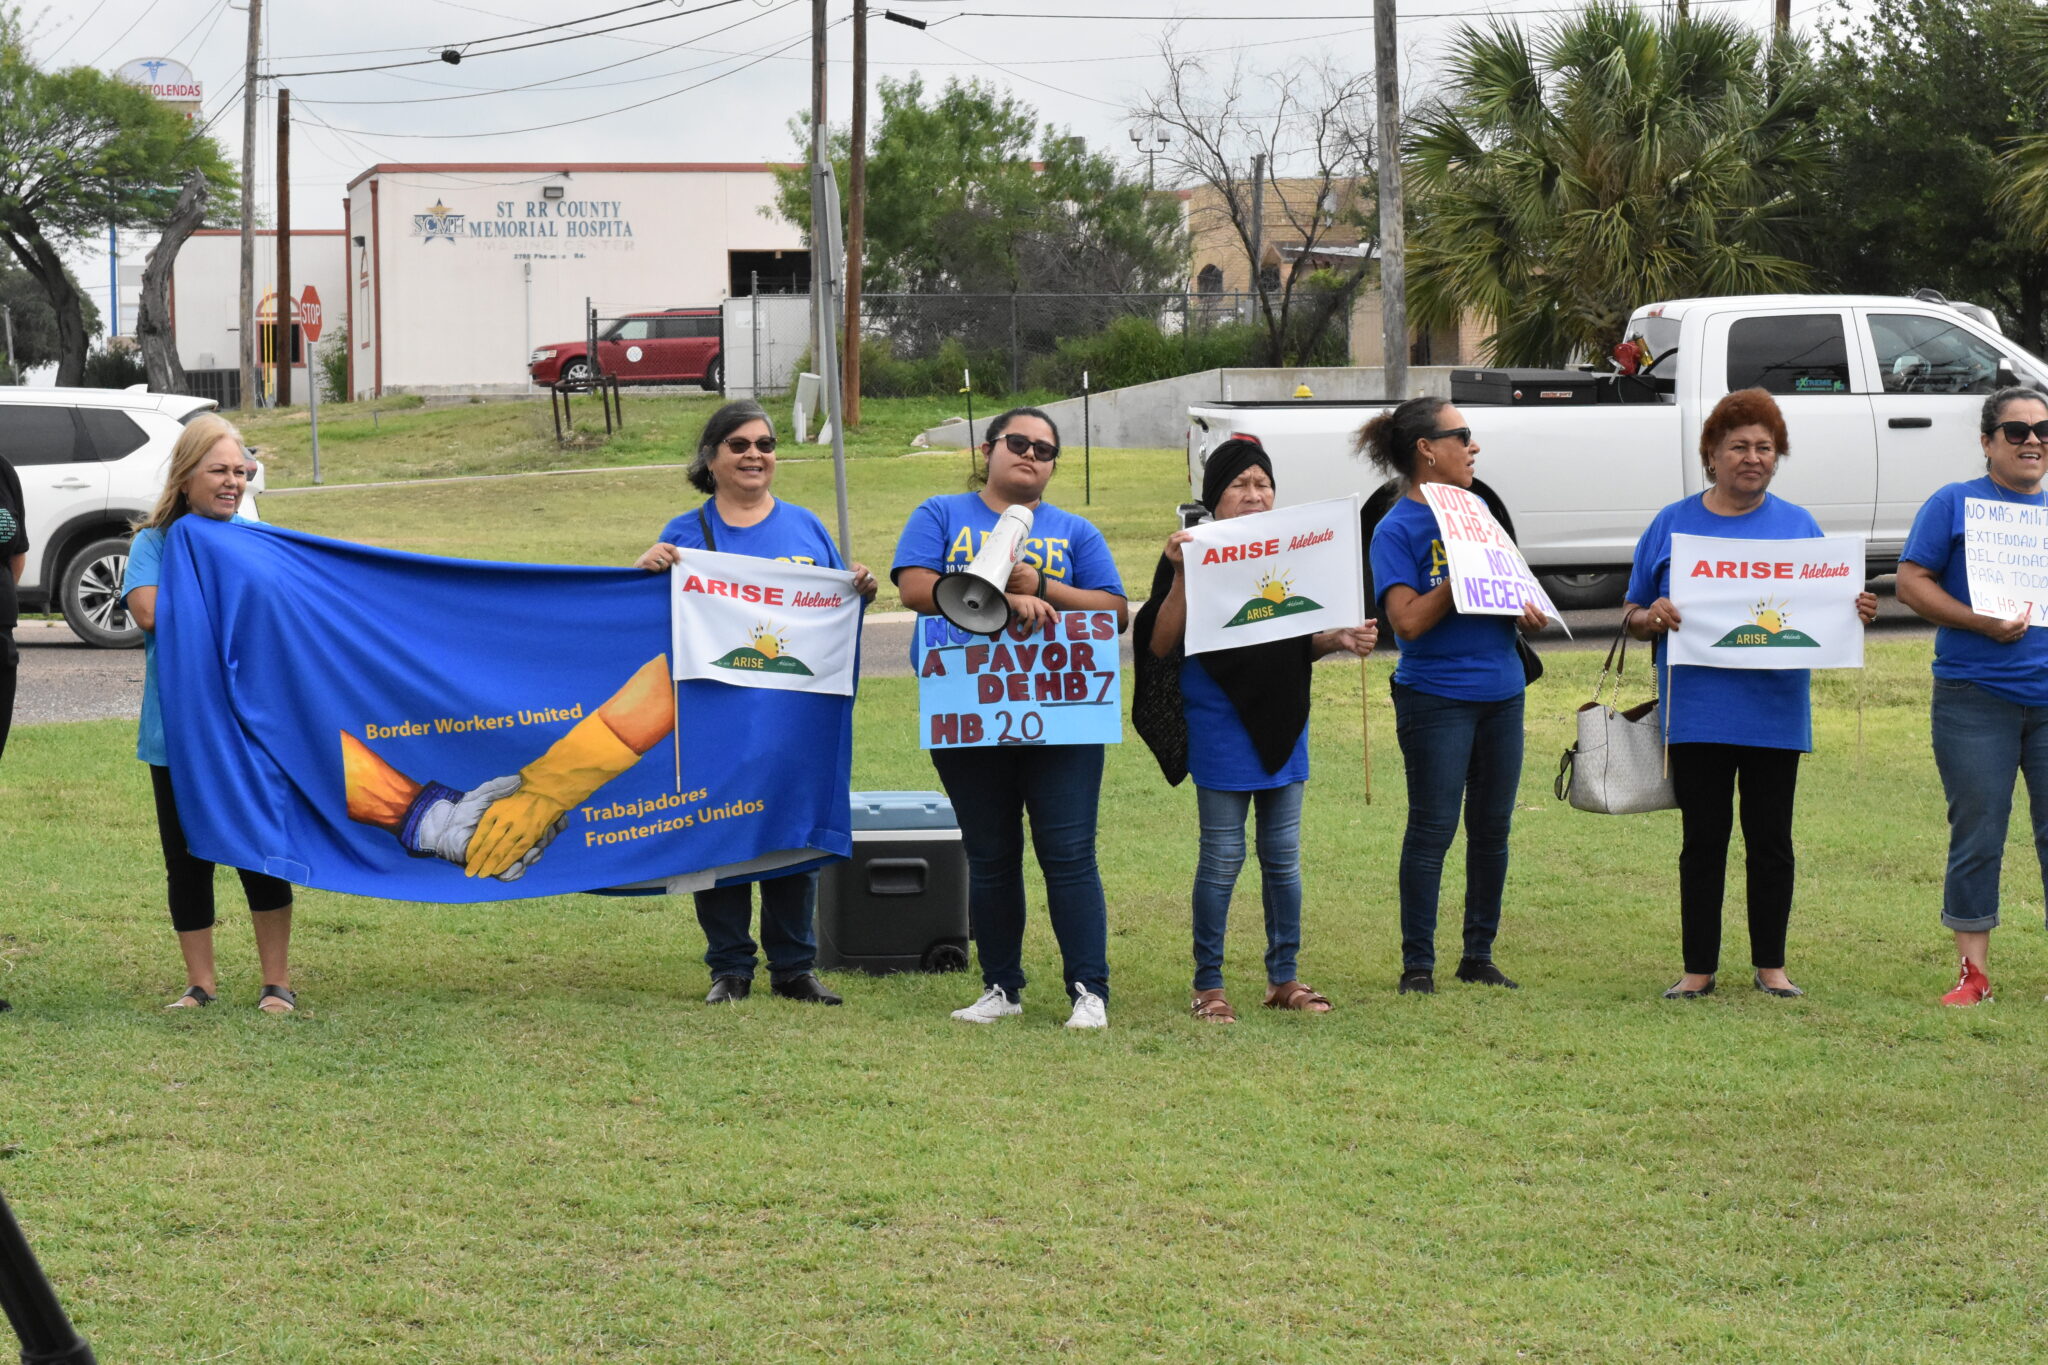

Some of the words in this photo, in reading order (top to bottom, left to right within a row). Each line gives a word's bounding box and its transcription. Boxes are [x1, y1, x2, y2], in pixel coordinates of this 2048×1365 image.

[557, 201, 621, 217] COUNTY
[413, 216, 465, 234] SCMH
[469, 221, 558, 237] MEMORIAL
[567, 221, 633, 237] HOSPITA
[302, 303, 321, 325] STOP
[1430, 485, 1478, 516] VOTE
[1966, 503, 1985, 519] NO
[1989, 504, 2013, 523] MAS
[1444, 512, 1461, 541] A
[1202, 539, 1280, 565] ARISE
[1288, 528, 1334, 552] Adelante
[1966, 529, 2037, 549] EXTIENDAN
[947, 526, 1069, 578] ASE
[1484, 548, 1512, 577] NO
[1967, 547, 1995, 563] DEL
[1690, 560, 1794, 579] ARISE
[1799, 562, 1850, 580] Adelante
[1968, 565, 2004, 585] PARA
[682, 575, 784, 606] ARISE
[792, 590, 842, 609] Adelante
[1247, 605, 1275, 621] ARISE
[1997, 596, 2018, 614] HB
[2023, 600, 2033, 617] 7
[925, 617, 973, 648] NO
[1736, 634, 1768, 645] ARISE
[733, 656, 764, 669] ARISE
[921, 649, 946, 678] A
[965, 642, 1097, 675] FAVOR
[366, 720, 430, 740] Border
[434, 715, 515, 734] Workers
[518, 703, 583, 726] United
[995, 711, 1043, 742] 20
[581, 787, 708, 822] Trabajadores
[585, 814, 694, 847] Fronterizos
[698, 799, 765, 824] Unidos
